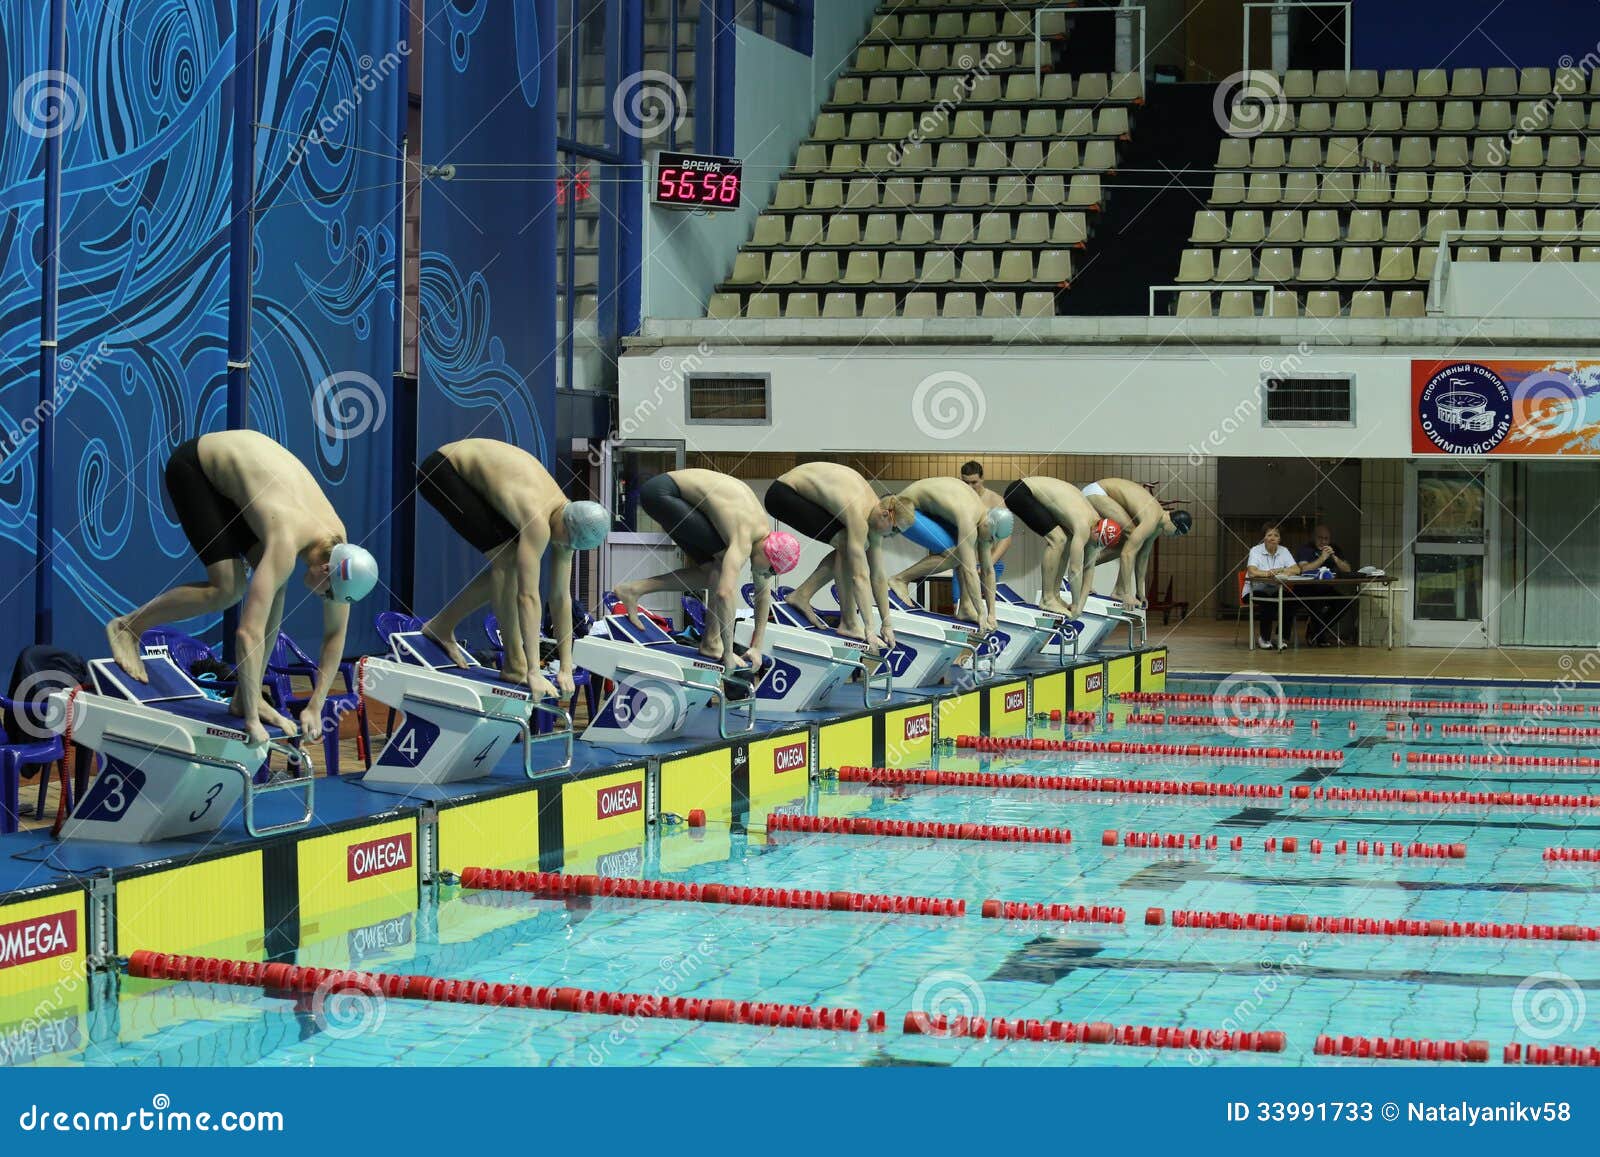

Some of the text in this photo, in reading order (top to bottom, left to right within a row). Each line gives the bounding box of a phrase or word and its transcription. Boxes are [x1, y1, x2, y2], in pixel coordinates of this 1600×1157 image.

[681, 159, 721, 172] ВРЕМЯ
[1423, 364, 1509, 402] СПОРТИВНЫЙ КОМПЛЕКС
[1422, 420, 1510, 455] ОЛИМПИЙСКИЙ
[891, 650, 906, 672] 7
[772, 669, 788, 693] 6
[613, 694, 632, 722] 5
[906, 717, 929, 737] OMEGA
[398, 728, 419, 760] 4
[473, 735, 500, 768] 4
[776, 746, 804, 771] OMEGA
[103, 773, 126, 813] 3
[189, 782, 224, 822] 3
[601, 787, 638, 814] OMEGA
[353, 840, 407, 875] OMEGA
